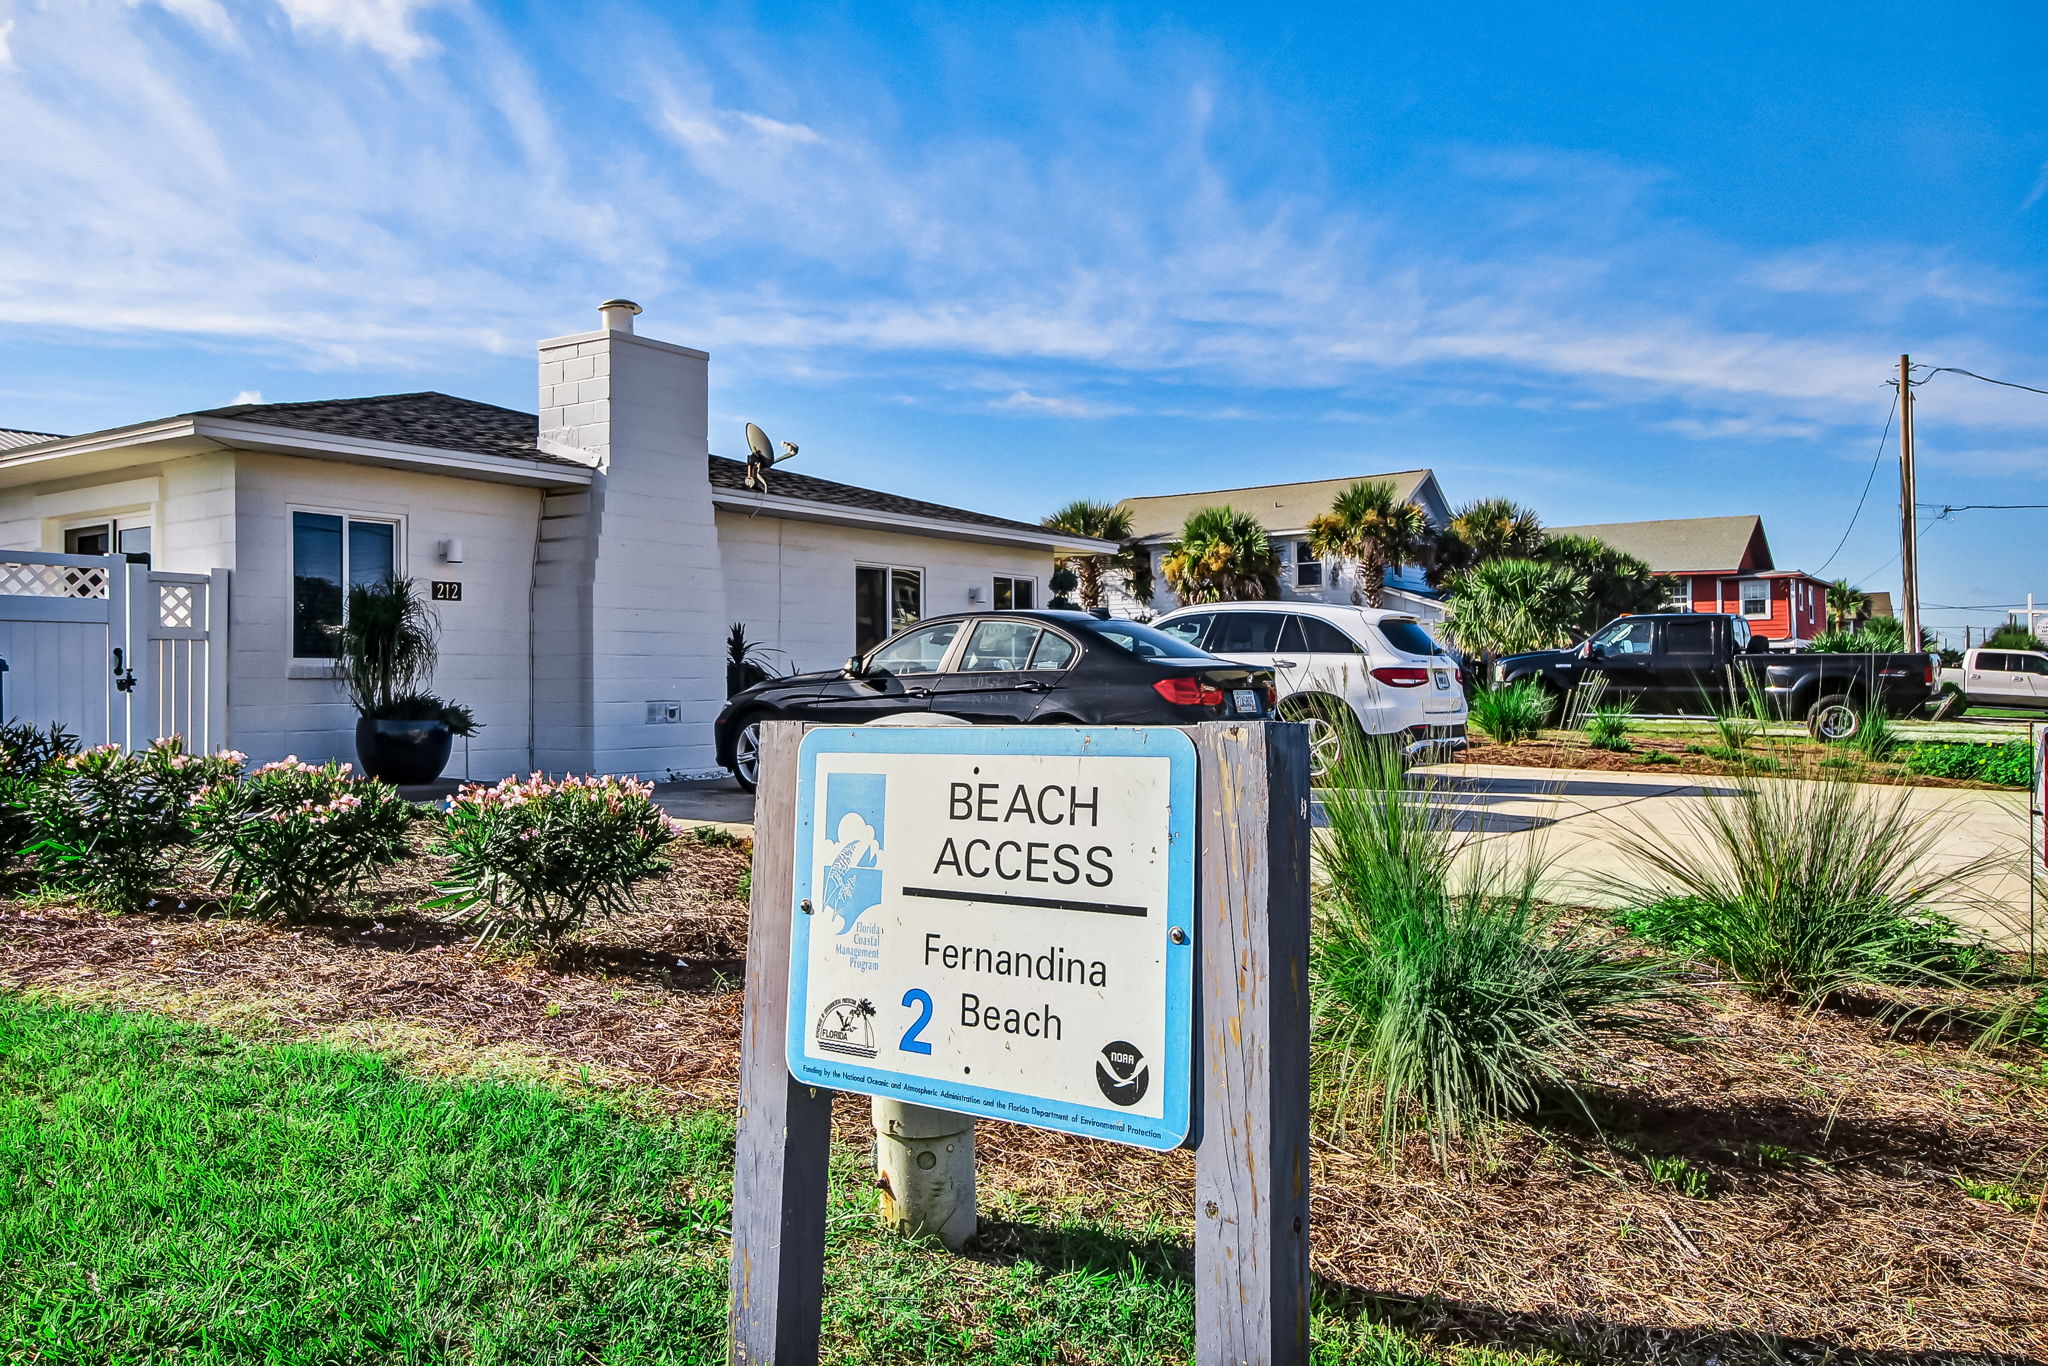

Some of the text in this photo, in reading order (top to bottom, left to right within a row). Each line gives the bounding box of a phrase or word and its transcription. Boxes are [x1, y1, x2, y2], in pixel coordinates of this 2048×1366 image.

[437, 583, 459, 599] 212
[949, 782, 1099, 827] BEACH
[933, 837, 1114, 887] ACCESS
[856, 921, 880, 934] Florida
[853, 933, 880, 947] Coastal
[835, 943, 879, 960] Management
[924, 932, 1107, 988] Fernandina
[849, 956, 879, 973] Program
[898, 988, 934, 1056] 2
[960, 992, 1062, 1041] Beach
[822, 1029, 848, 1041] FLORIDA
[1111, 1052, 1134, 1065] NOAA
[803, 1064, 1162, 1139] Funding by the National Oceanic and Atmospheric Administration and the Florida Department of Environmental Protection
